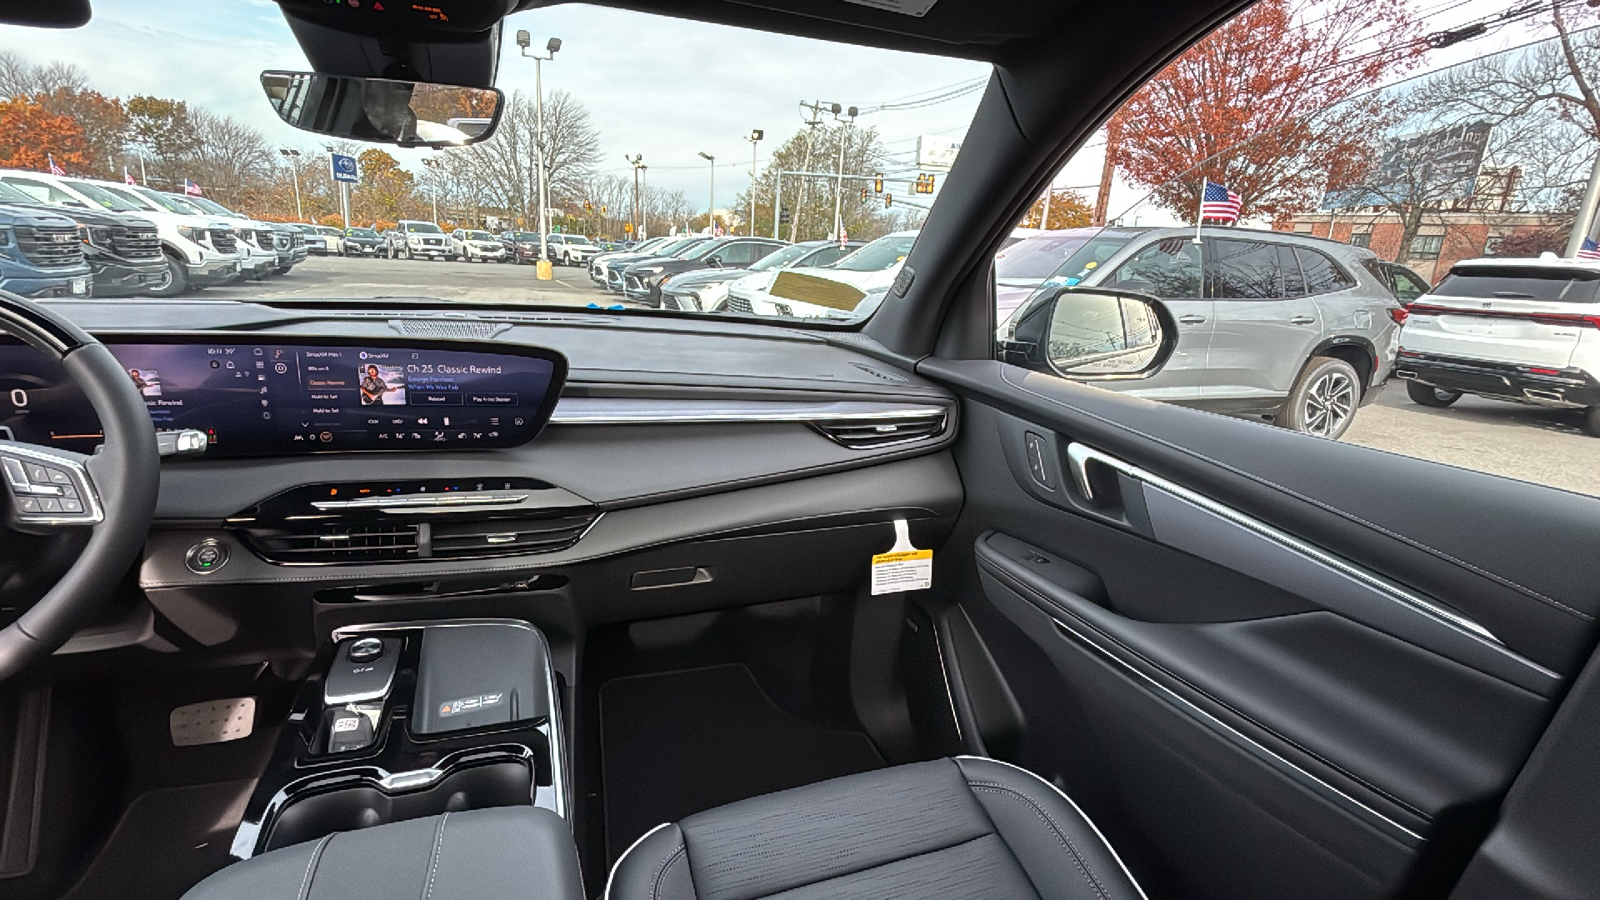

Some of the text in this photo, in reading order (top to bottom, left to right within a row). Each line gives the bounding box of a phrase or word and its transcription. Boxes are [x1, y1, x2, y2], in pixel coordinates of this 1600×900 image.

[407, 364, 419, 373] Ch
[421, 364, 433, 373] 25
[437, 364, 468, 374] Classic
[469, 365, 502, 374] Rewind
[11, 388, 28, 407] 0
